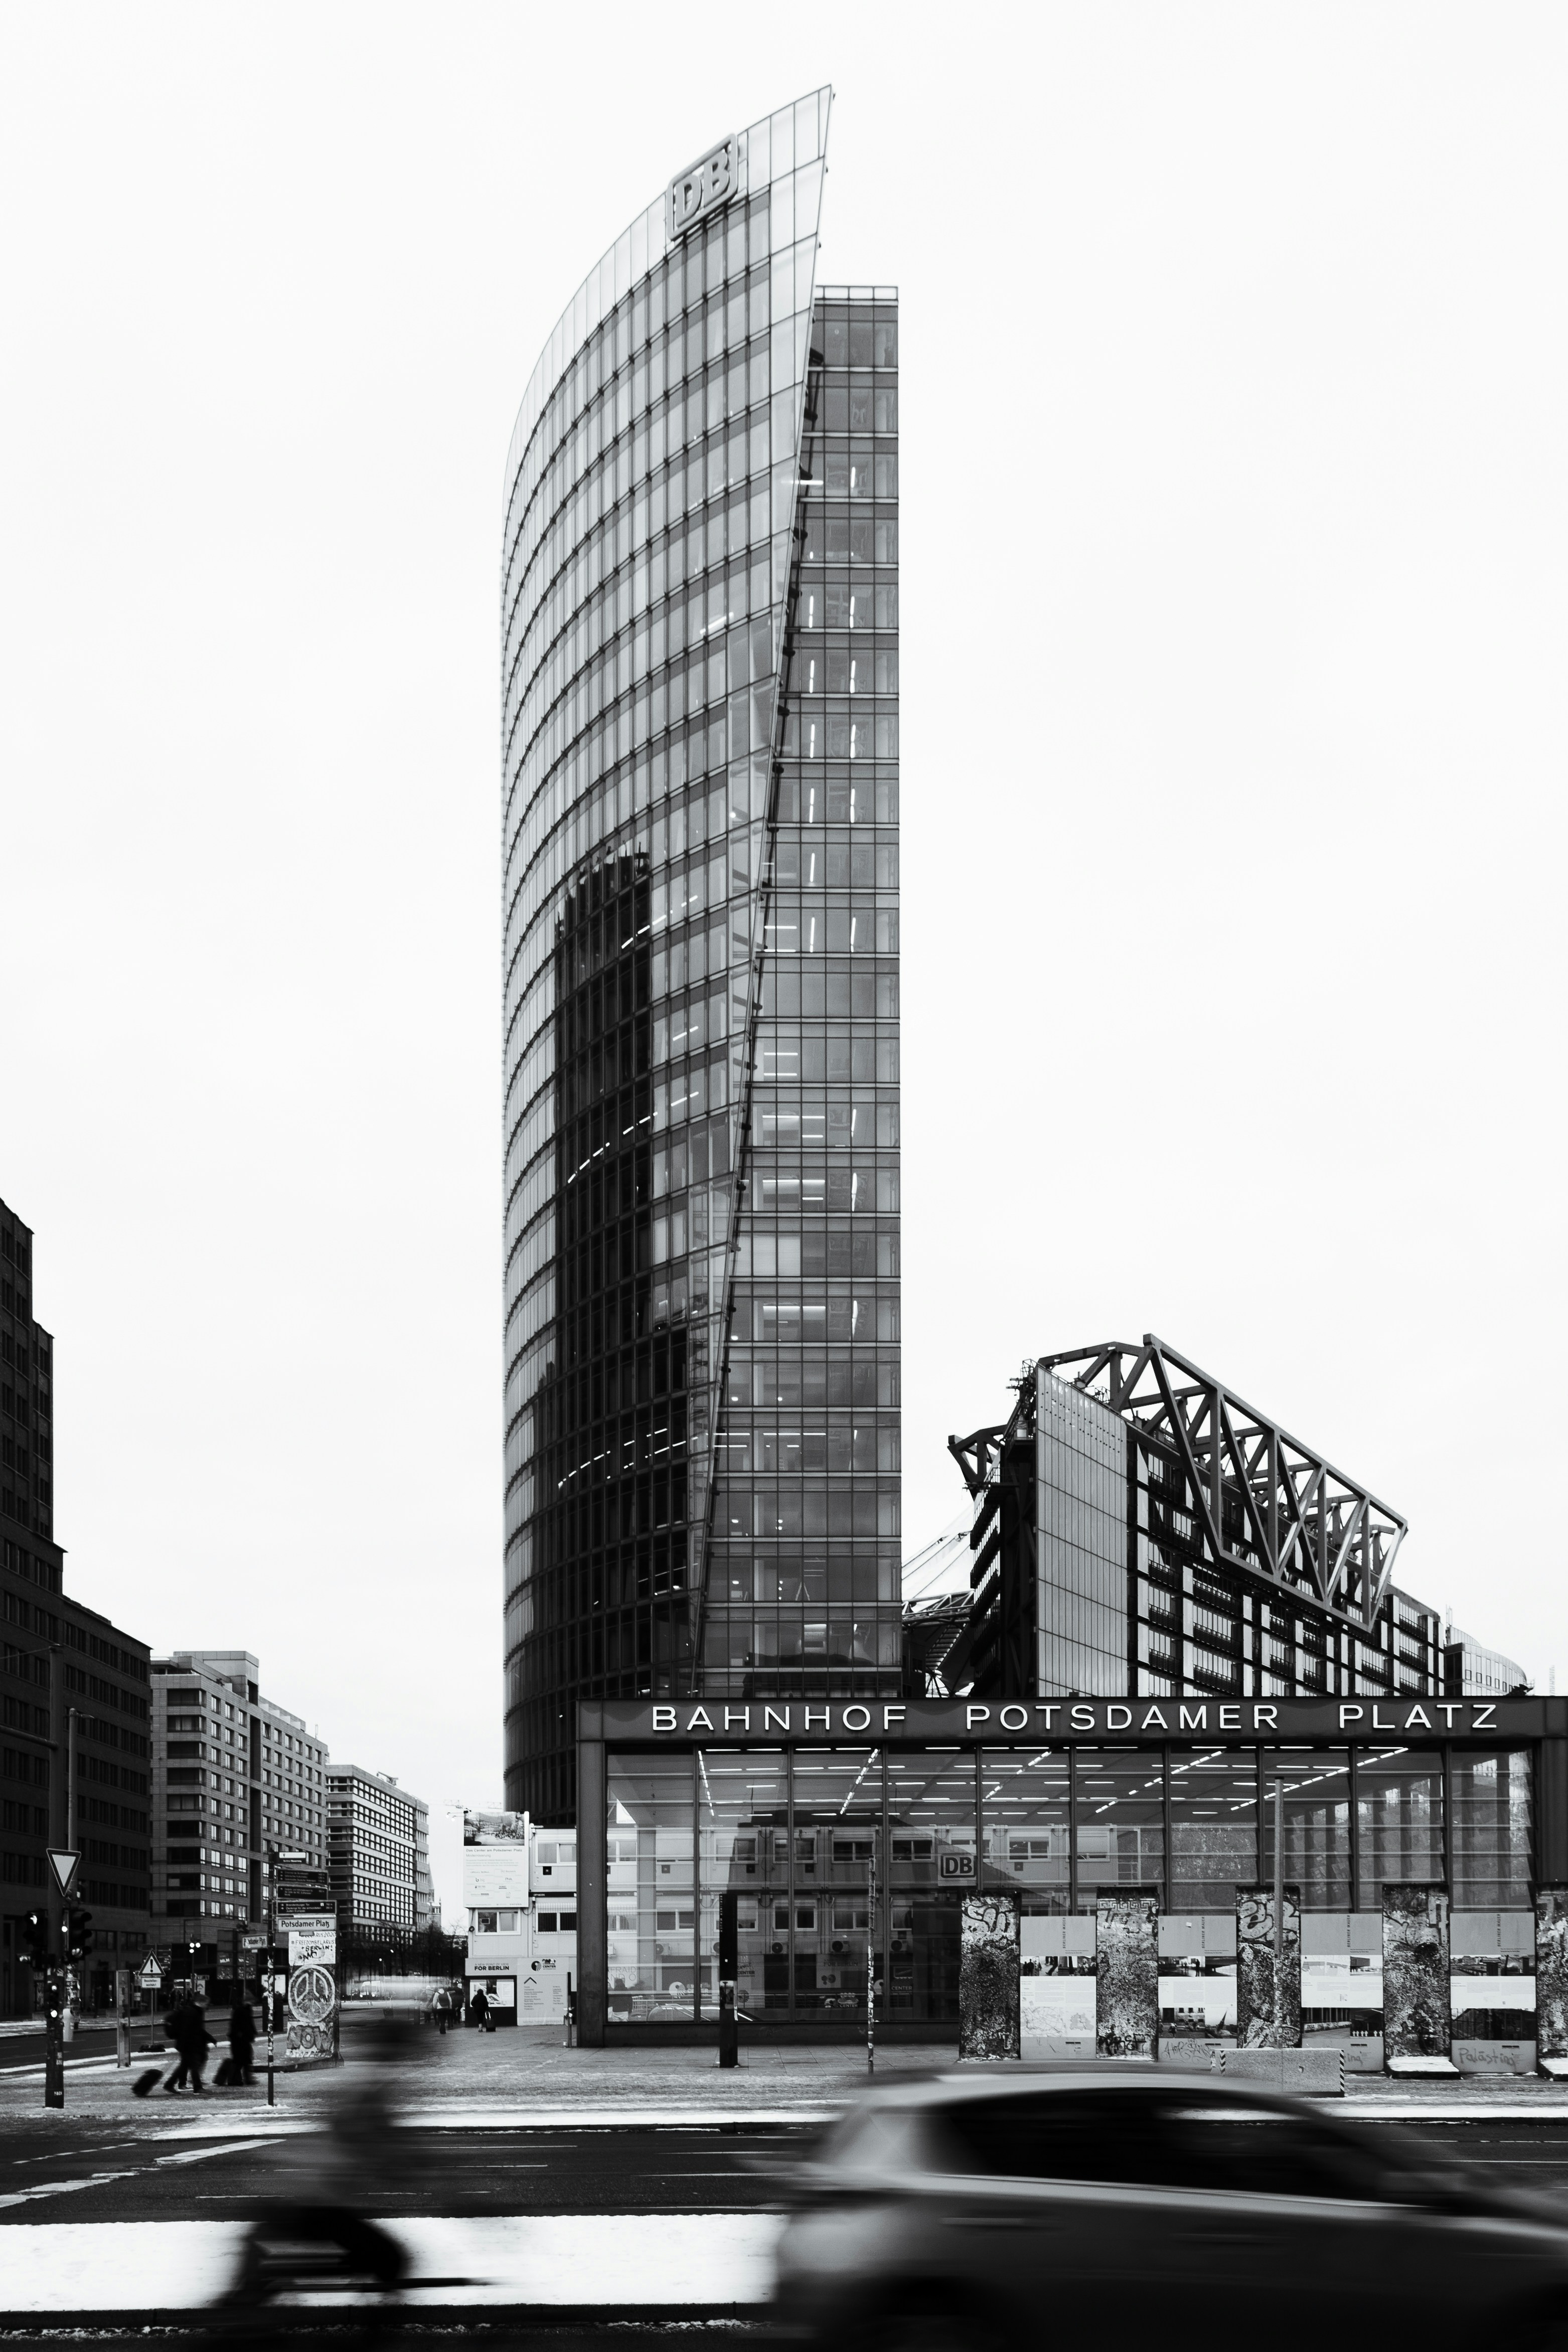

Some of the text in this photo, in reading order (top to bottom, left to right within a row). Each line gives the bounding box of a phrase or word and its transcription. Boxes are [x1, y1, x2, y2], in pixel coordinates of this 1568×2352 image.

[676, 151, 730, 227] DB
[652, 1704, 1497, 1731] BAHNHOF POTSDAMER PLATZ
[945, 1856, 973, 1874] DB
